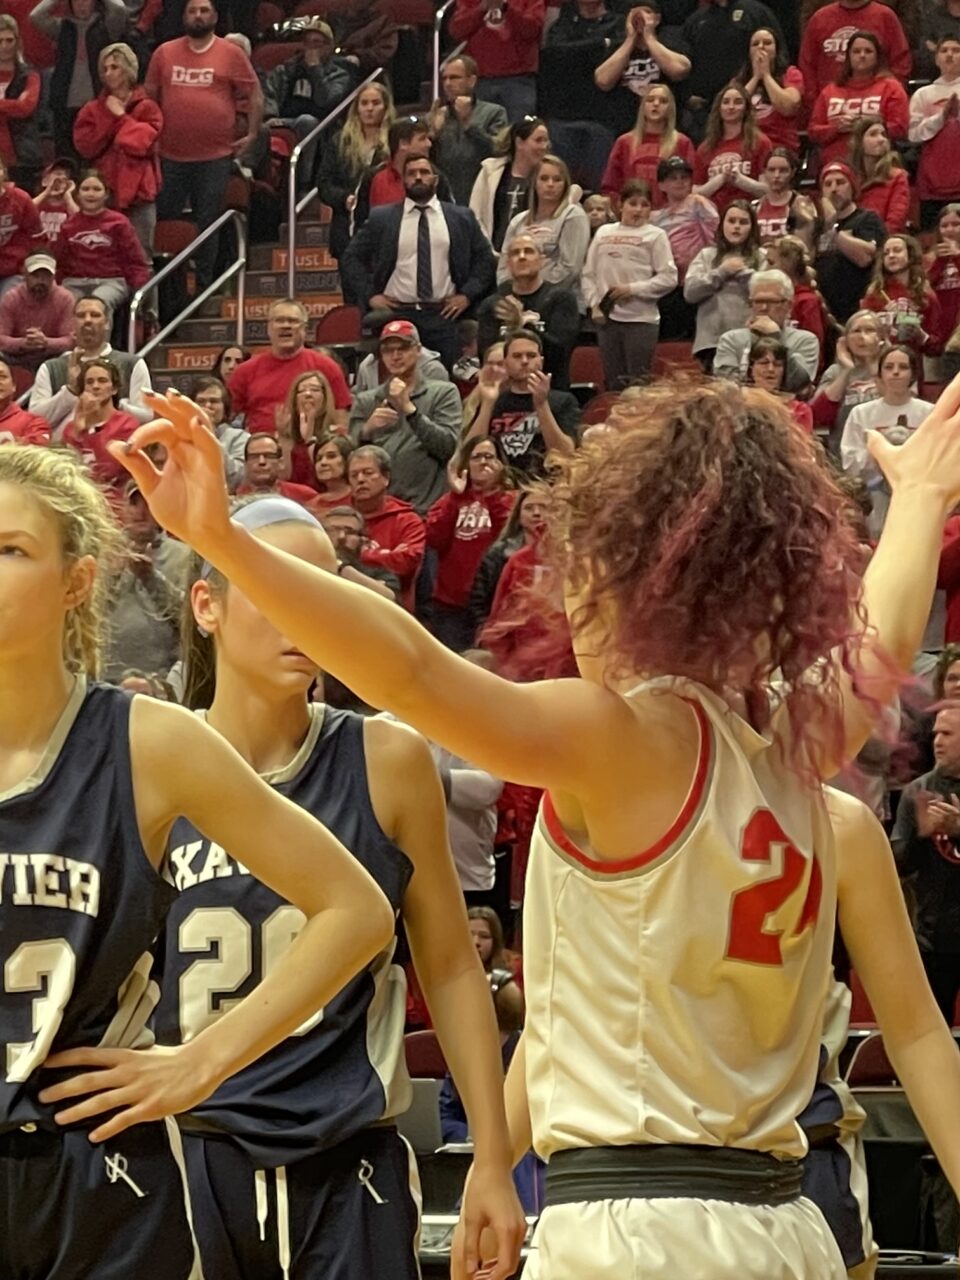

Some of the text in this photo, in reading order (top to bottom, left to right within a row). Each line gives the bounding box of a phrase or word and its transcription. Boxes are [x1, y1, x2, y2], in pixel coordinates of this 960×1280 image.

[171, 65, 215, 84] DCG
[827, 95, 882, 116] DCG
[279, 253, 319, 266] Tust
[227, 303, 268, 317] Tust
